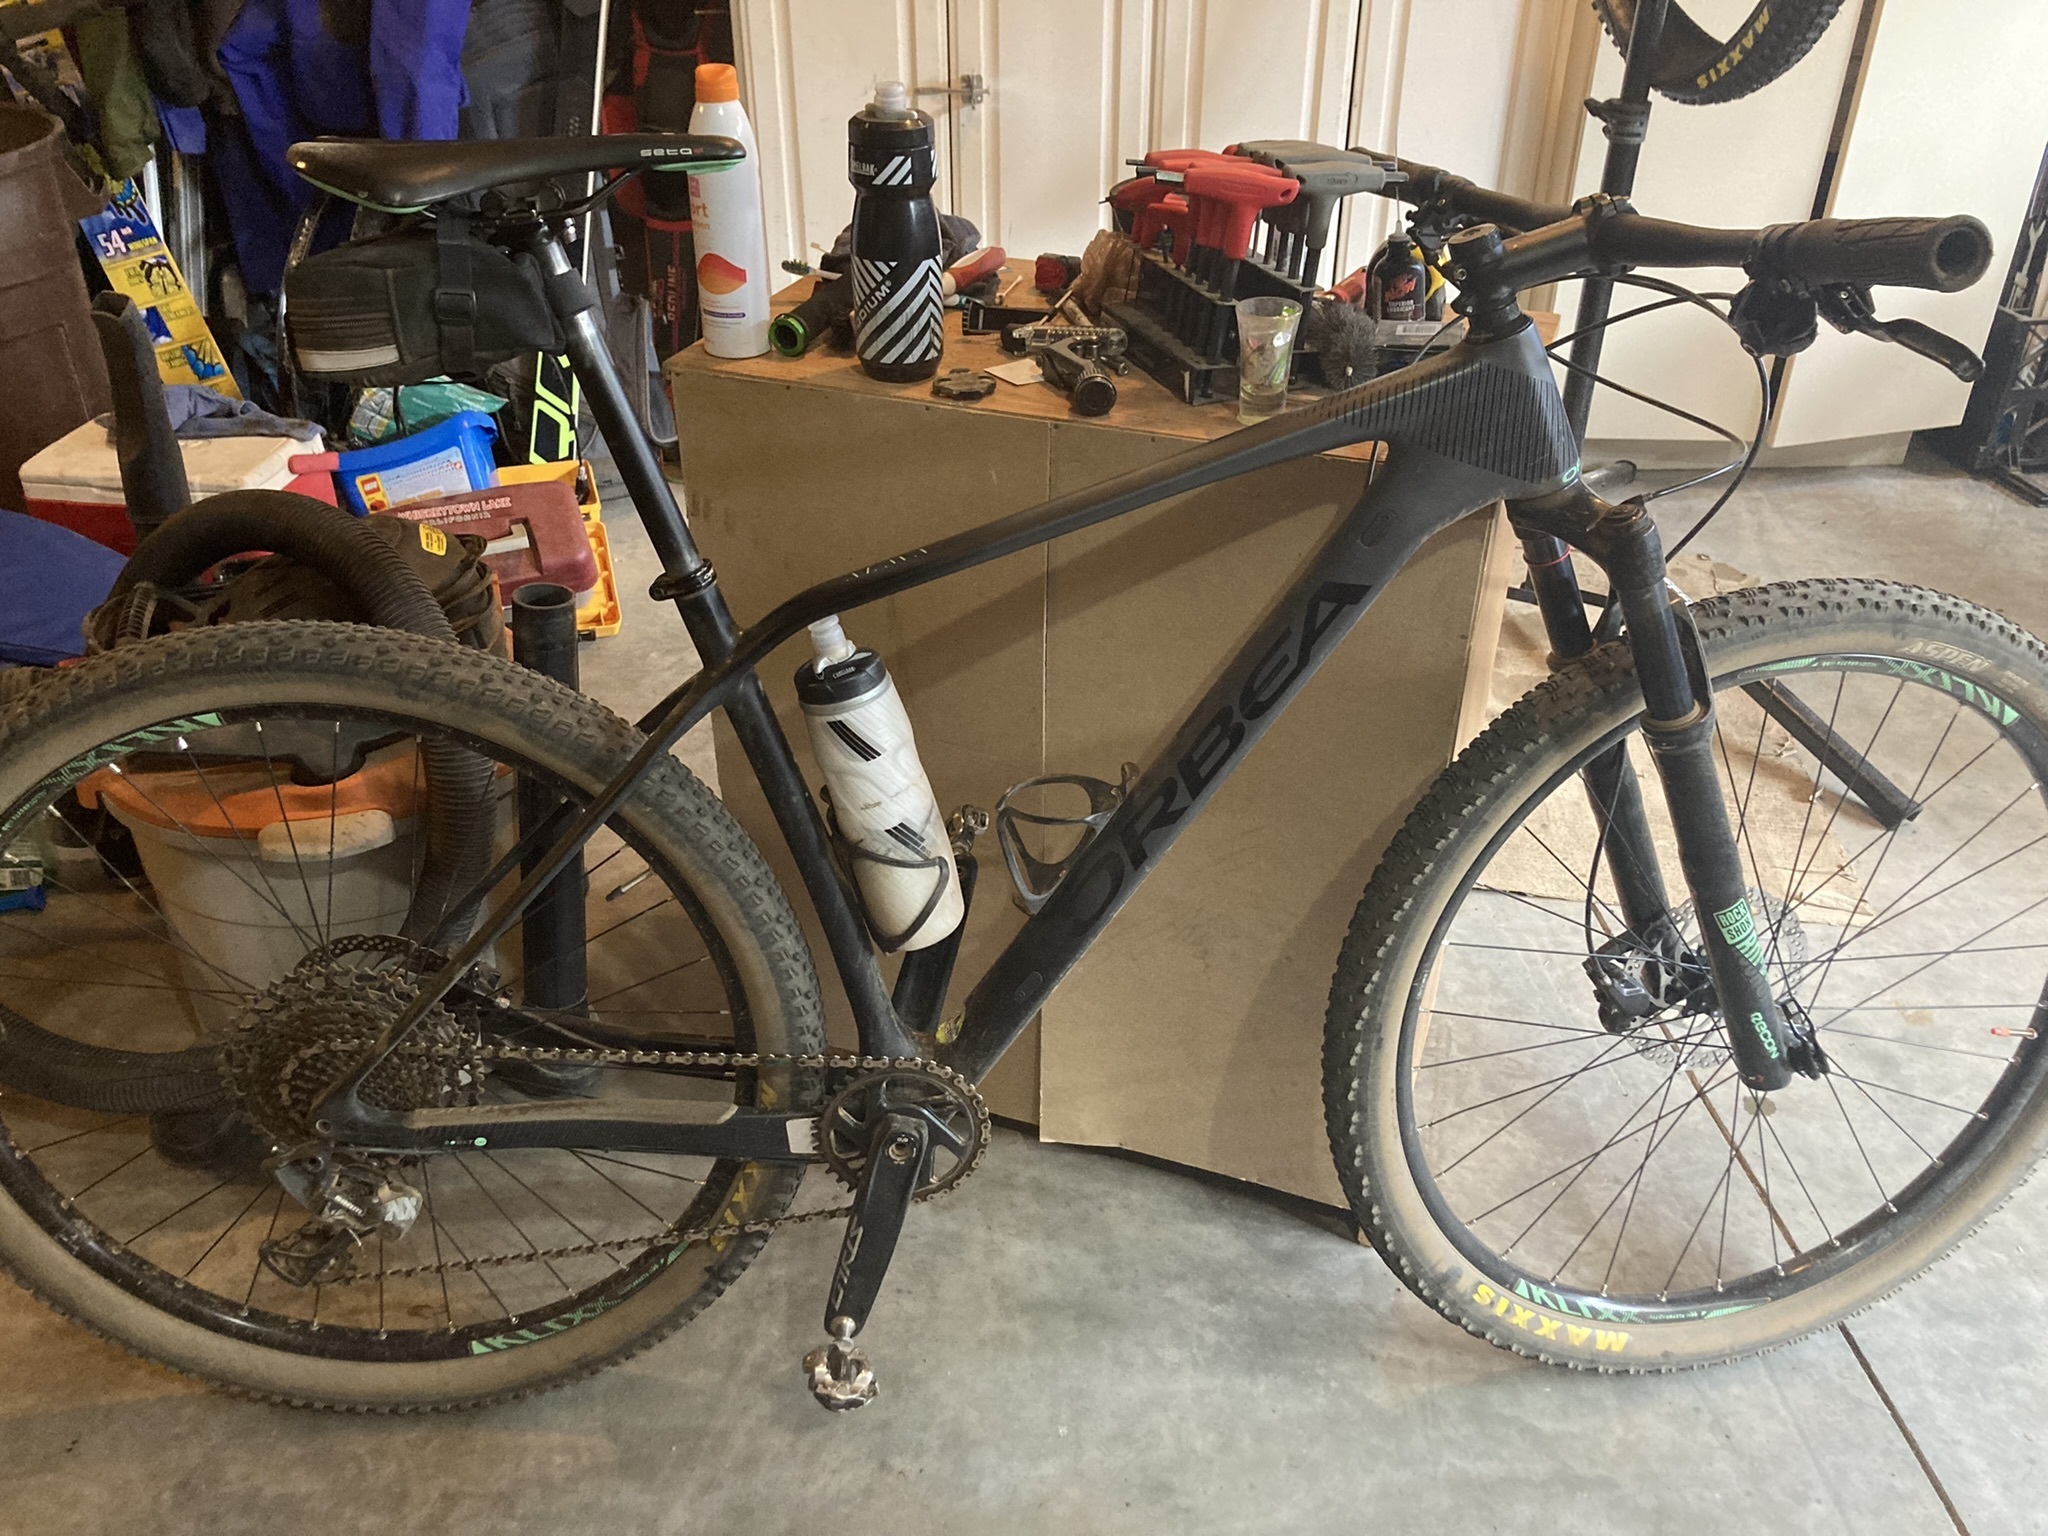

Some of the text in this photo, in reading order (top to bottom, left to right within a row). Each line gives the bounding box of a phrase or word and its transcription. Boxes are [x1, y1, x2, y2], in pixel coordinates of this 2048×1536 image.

[1695, 5, 1770, 89] MAXXIS
[96, 228, 127, 257] 54
[481, 496, 512, 512] LAKE
[1906, 639, 1992, 673] ASPEN
[1066, 580, 1374, 938] ORBEA
[1717, 902, 1748, 929] ROCK
[1750, 1011, 1780, 1060] RECON
[1471, 1283, 1630, 1353] MAXXIS
